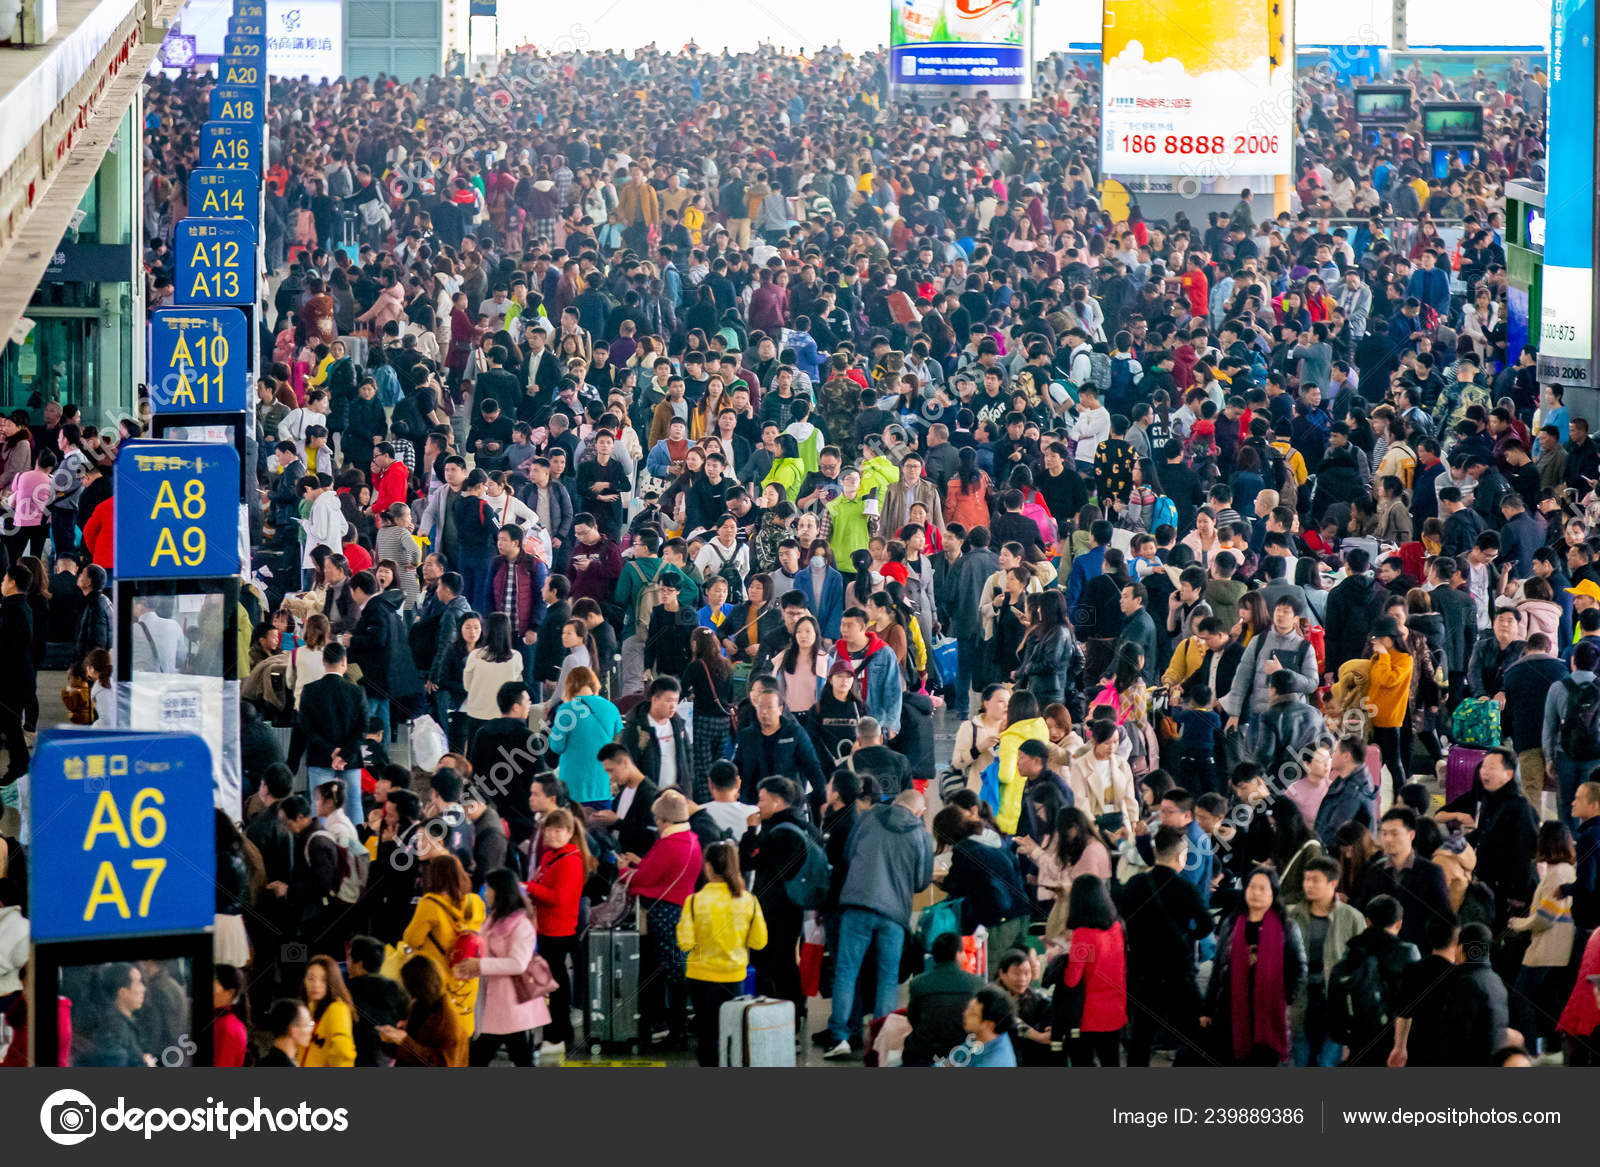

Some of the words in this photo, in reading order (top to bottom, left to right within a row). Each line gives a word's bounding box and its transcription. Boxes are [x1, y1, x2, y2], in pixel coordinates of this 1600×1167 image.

[225, 67, 257, 84] A20
[220, 101, 254, 120] A18
[212, 138, 250, 160] A16
[1122, 135, 1157, 154] 186
[1164, 136, 1225, 155] 8888
[1232, 136, 1279, 155] 2006
[202, 188, 245, 212] A14
[190, 241, 240, 268] A12
[190, 271, 240, 297] A13
[169, 335, 229, 368] A10
[1562, 367, 1587, 380] 2006
[171, 372, 224, 405] A11
[150, 479, 206, 520] A8
[150, 526, 206, 567] A9
[63, 754, 128, 780] 检票口
[83, 787, 166, 851] A6
[83, 858, 167, 922] A7
